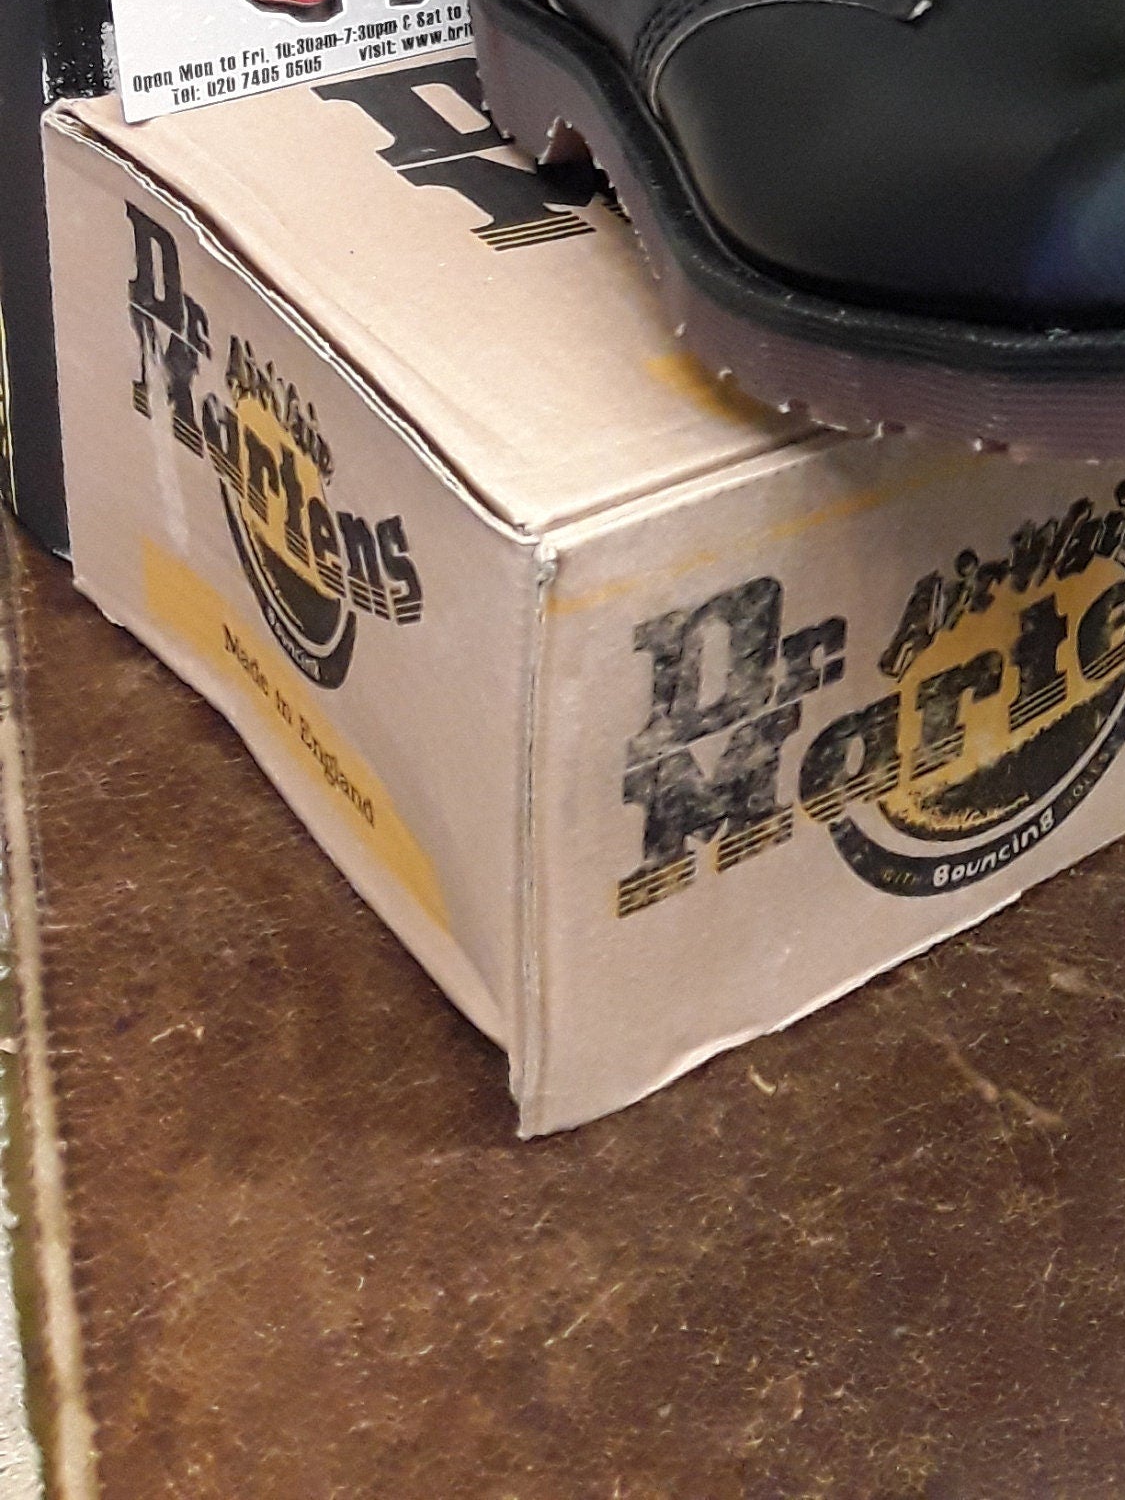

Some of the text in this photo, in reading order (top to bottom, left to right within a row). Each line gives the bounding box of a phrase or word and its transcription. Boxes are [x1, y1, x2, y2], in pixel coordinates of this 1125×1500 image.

[132, 68, 174, 94] Open
[178, 59, 214, 83] Mon
[219, 54, 237, 73] to
[242, 48, 271, 68] Fri.
[416, 8, 443, 28] Sat
[446, 5, 462, 21] to
[172, 86, 201, 107] Tel:
[206, 76, 236, 98] 020
[400, 22, 474, 52] www.brit
[130, 312, 424, 626] Martens
[299, 714, 376, 830] England
[932, 804, 1056, 889] Bouncing
